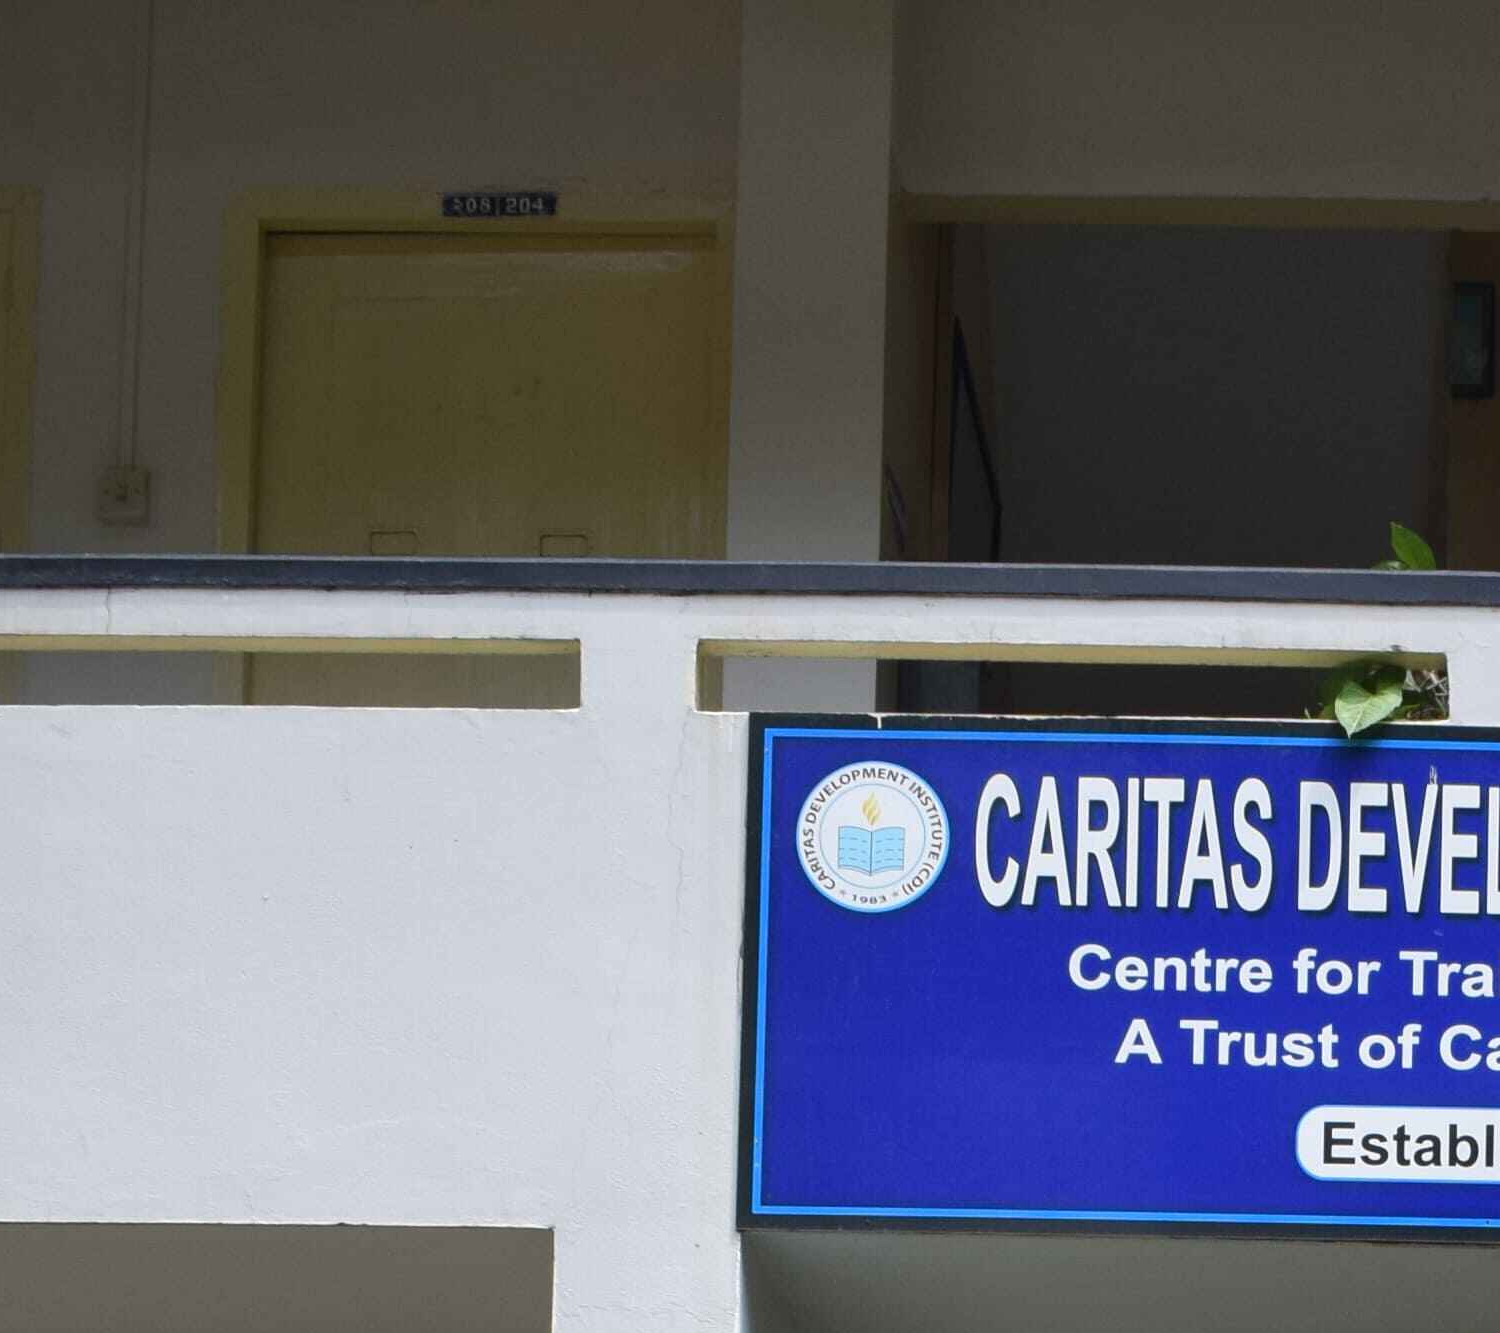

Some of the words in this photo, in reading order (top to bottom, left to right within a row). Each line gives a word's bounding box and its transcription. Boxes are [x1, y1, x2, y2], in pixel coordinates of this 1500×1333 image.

[806, 767, 909, 824] DEVELOPMENT
[908, 782, 943, 861] INSTITUTE
[803, 829, 835, 890] CARITAS
[974, 772, 1274, 913] CARITAS
[901, 862, 934, 895] (CDI)
[1067, 942, 1274, 994] Centre
[1291, 946, 1383, 996] for
[1113, 1017, 1164, 1065] A
[1178, 1018, 1340, 1069] Trust
[1357, 1022, 1423, 1070] of
